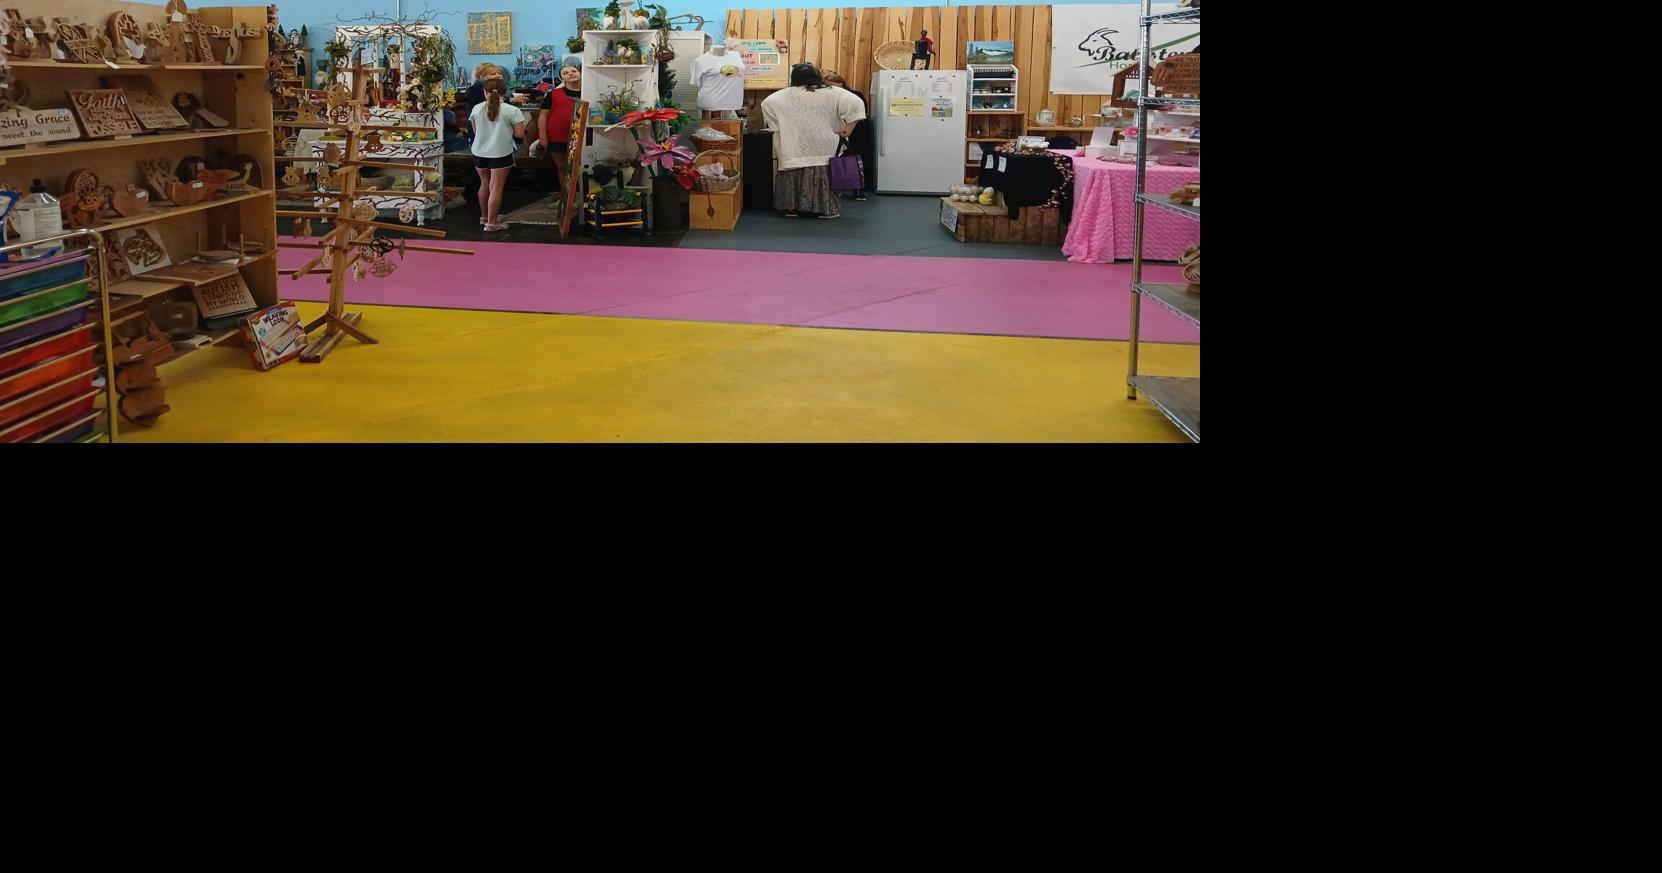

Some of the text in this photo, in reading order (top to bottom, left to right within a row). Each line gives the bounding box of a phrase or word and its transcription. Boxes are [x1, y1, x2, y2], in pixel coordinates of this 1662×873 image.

[35, 114, 70, 124] Grace
[30, 129, 43, 137] the
[49, 127, 71, 135] sound
[201, 282, 240, 294] AUTISM
[262, 309, 288, 324] WEAVING
